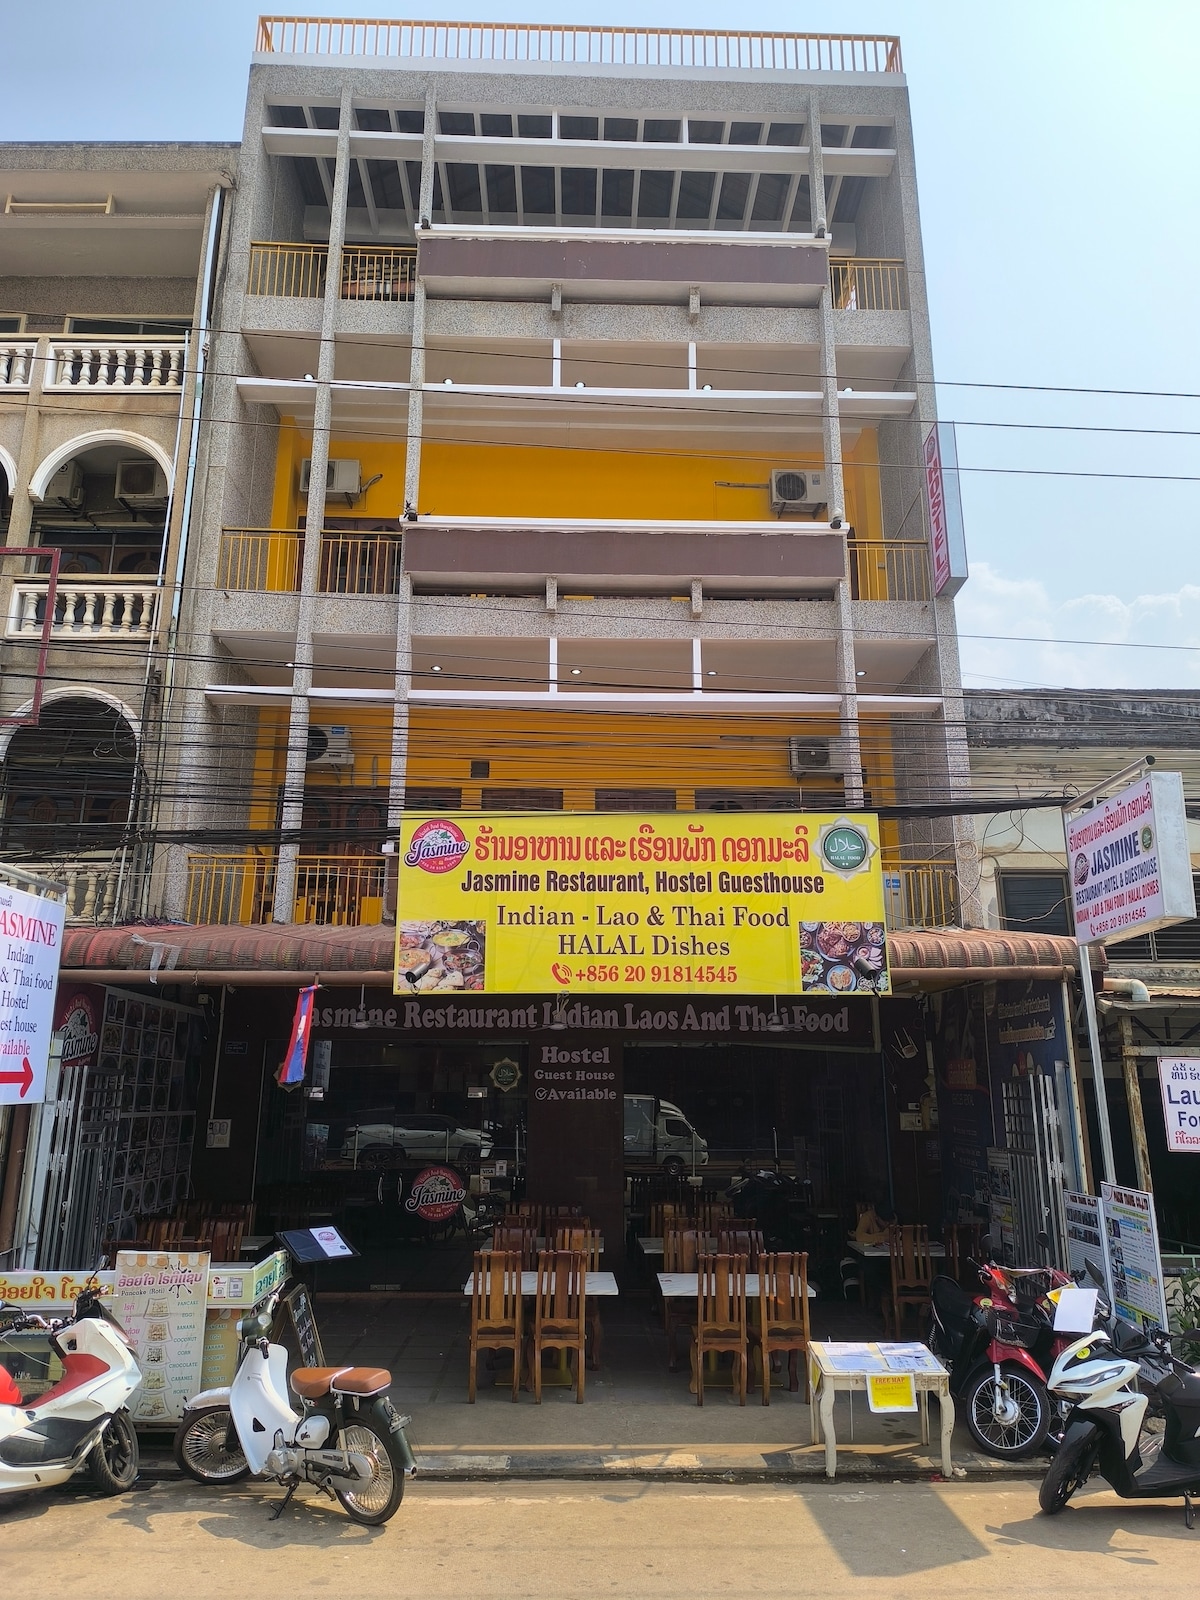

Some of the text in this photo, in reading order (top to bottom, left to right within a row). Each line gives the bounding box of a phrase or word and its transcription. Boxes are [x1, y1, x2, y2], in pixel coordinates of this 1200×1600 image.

[927, 457, 947, 572] HOSTEL
[405, 839, 471, 867] Jasmine
[829, 837, 862, 852] حلال
[1090, 830, 1141, 876] JASMINE
[461, 870, 825, 894] Jasmine Restaurant, Hostel Guesthouse
[1124, 857, 1158, 885] GUESTHOUSE
[1114, 893, 1125, 909] FOOD
[1128, 888, 1142, 904] HALAL
[1143, 879, 1160, 898] DISHES
[497, 905, 575, 926] Indian
[596, 905, 639, 926] Lao
[646, 905, 665, 926] &
[672, 906, 725, 926] Thai
[733, 906, 790, 927] Food
[1110, 917, 1117, 929] 20
[1118, 907, 1147, 926] 91814545
[7, 944, 35, 965] Indian
[558, 934, 730, 956] HALAL Dishes
[0, 966, 54, 990] & Thai food
[575, 965, 738, 983] +856 20 91814545
[1, 990, 30, 1010] Hostel
[14, 1015, 38, 1033] house
[293, 1002, 398, 1029] asmne
[403, 1001, 538, 1029] Restaurant
[542, 1001, 620, 1030] Indian
[625, 1002, 679, 1031] Laos
[680, 1002, 731, 1032] And
[792, 1005, 850, 1033] Food
[541, 1046, 611, 1065] Hostel
[534, 1068, 615, 1081] Guest House
[548, 1087, 617, 1101] Available
[405, 1184, 467, 1212] Jasmine
[121, 1289, 147, 1297] Pancake
[168, 1361, 198, 1369] CHOCOLATE
[891, 1376, 906, 1384] MAP
